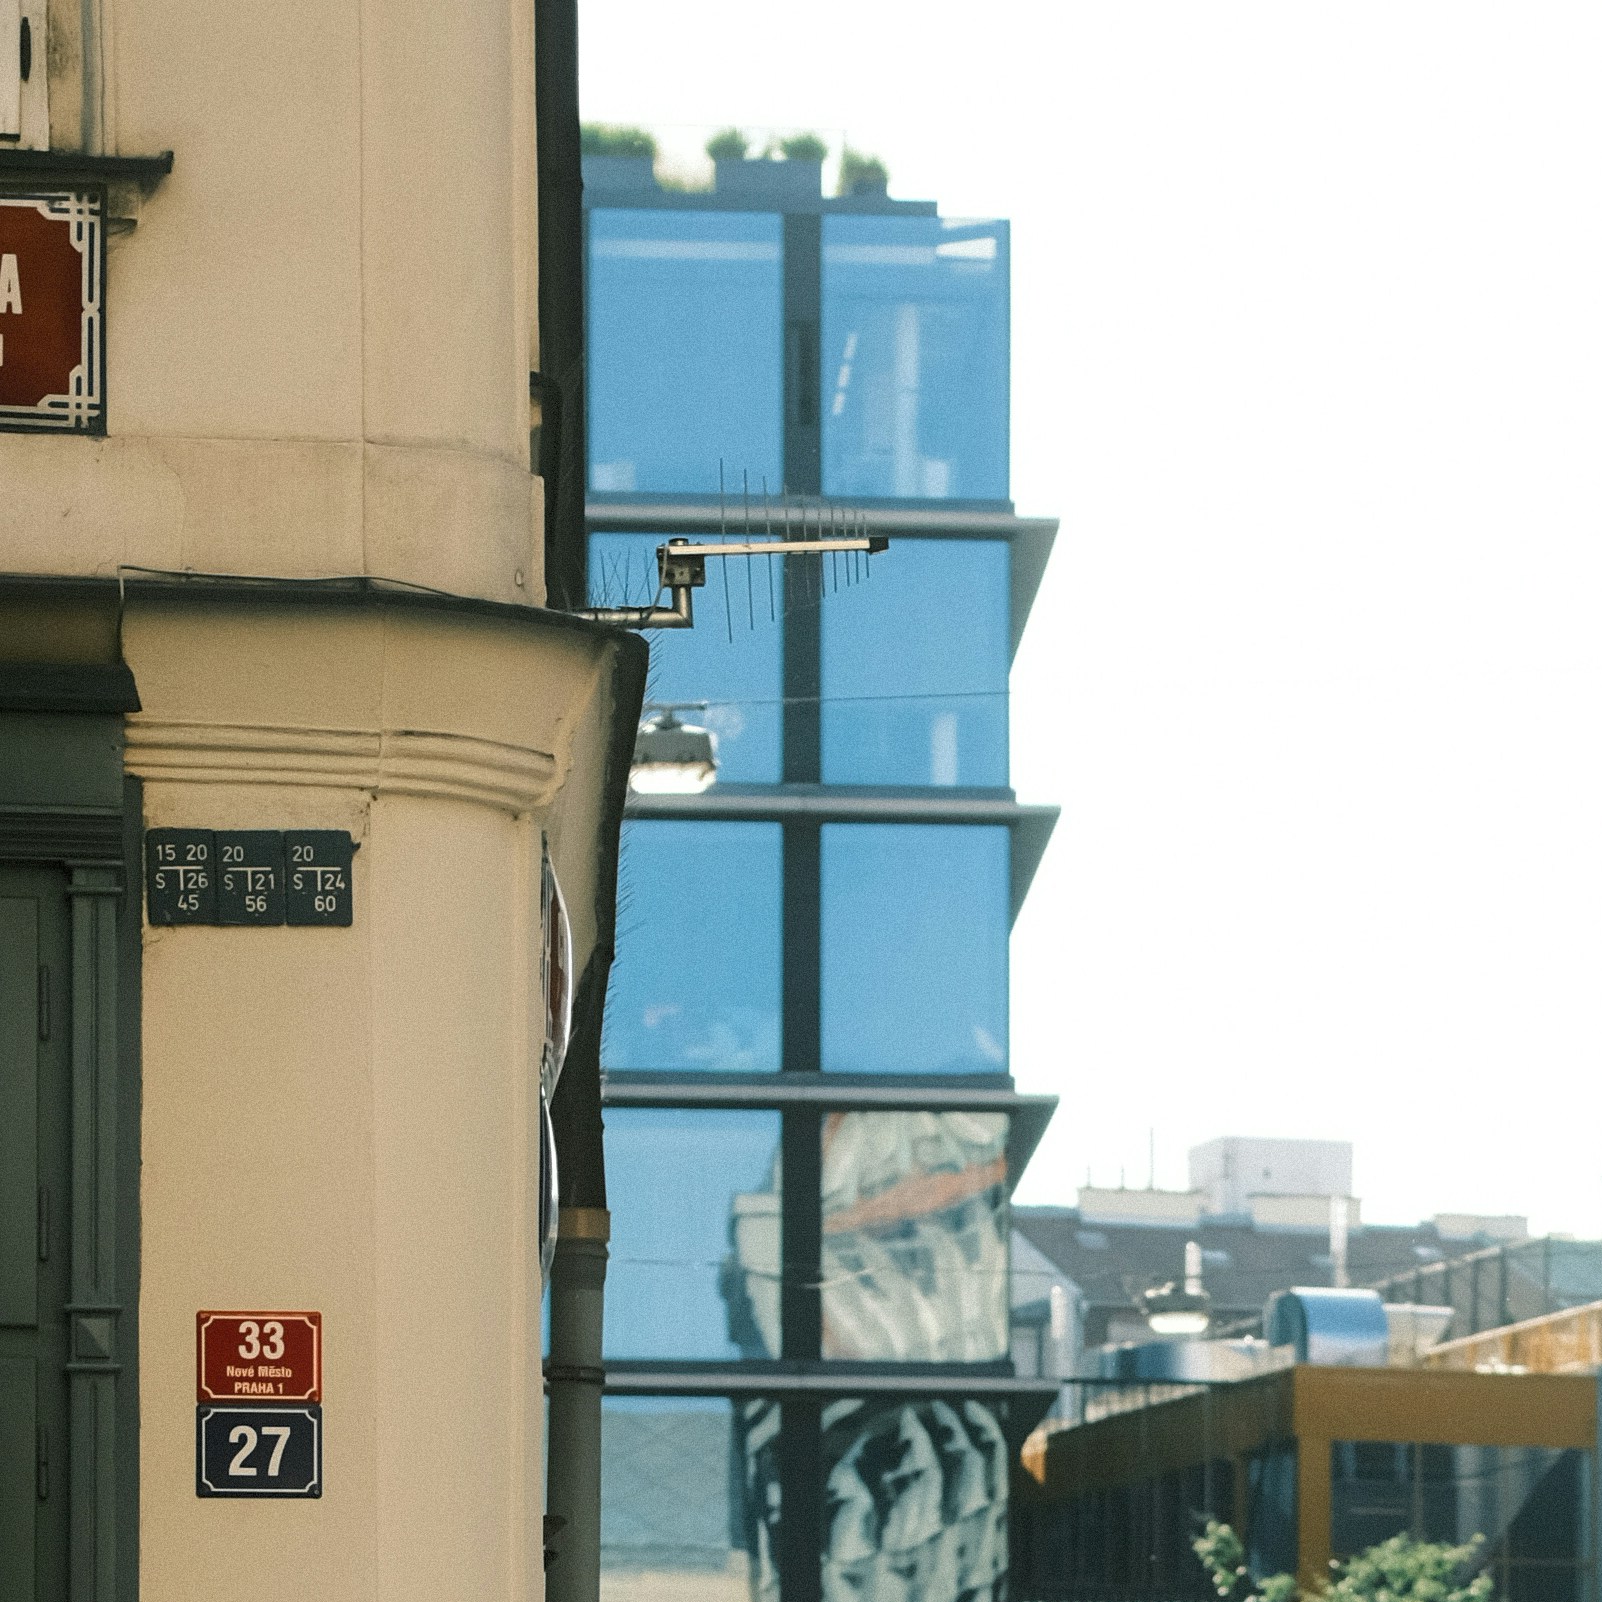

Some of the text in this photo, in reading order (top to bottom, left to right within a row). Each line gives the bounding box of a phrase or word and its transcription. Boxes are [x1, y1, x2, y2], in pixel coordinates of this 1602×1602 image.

[156, 844, 208, 861] 15 20
[222, 846, 244, 862] 20
[292, 845, 314, 862] 20
[155, 872, 209, 889] S 26
[224, 873, 275, 891] S 21
[293, 873, 346, 890] S 24
[178, 894, 199, 911] 45
[245, 895, 267, 912] 56
[314, 895, 336, 912] 60
[238, 1320, 285, 1360] 33
[226, 1365, 293, 1378] Nové Město
[234, 1381, 284, 1395] PRAHA 1
[228, 1425, 291, 1477] 27
